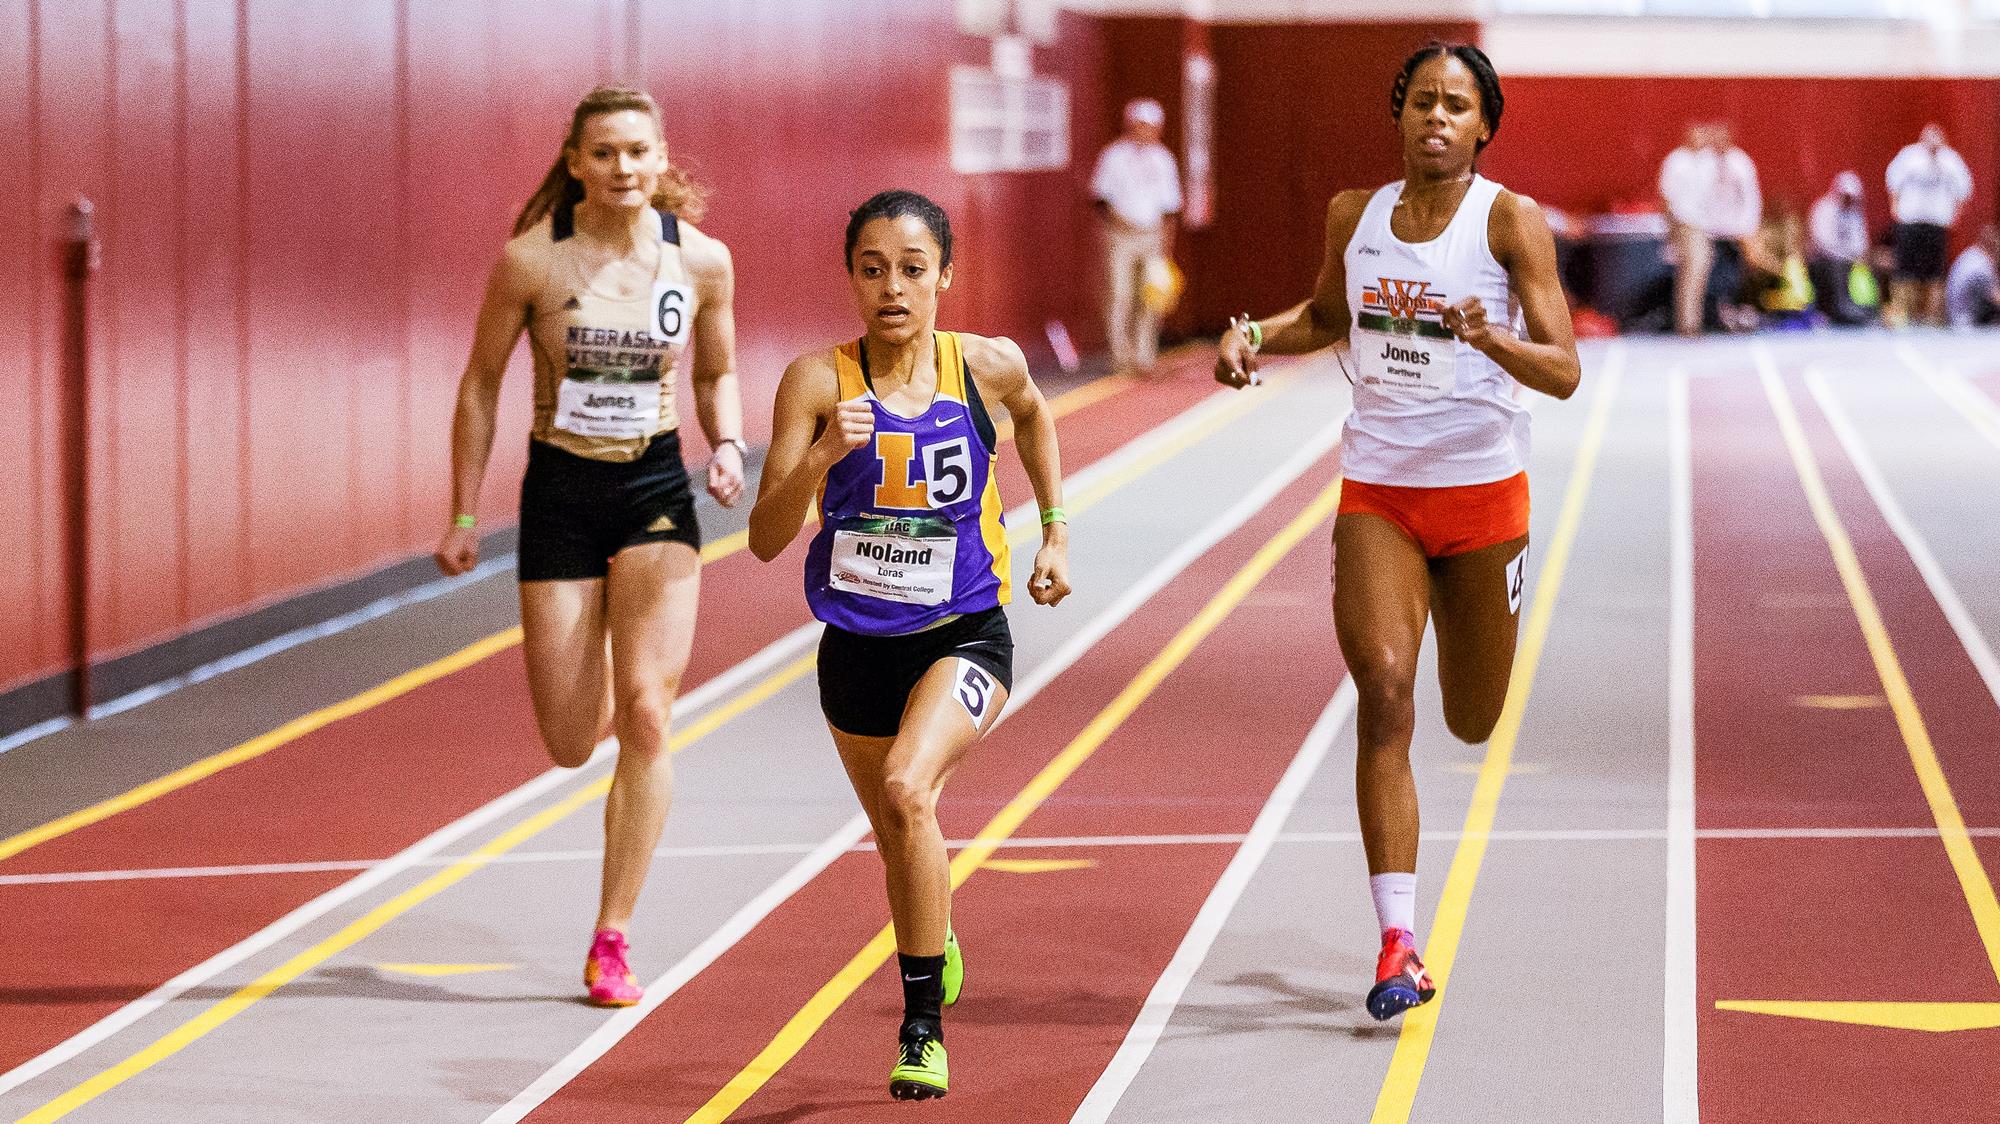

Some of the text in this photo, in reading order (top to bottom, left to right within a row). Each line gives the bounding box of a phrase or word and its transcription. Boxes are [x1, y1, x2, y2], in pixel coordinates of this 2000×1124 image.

[658, 289, 684, 337] 6
[1378, 277, 1431, 320] W
[1381, 342, 1431, 365] Jones
[873, 431, 938, 510] L
[932, 444, 967, 504] 5
[856, 541, 932, 565] Noland
[877, 567, 904, 578] Loras
[960, 666, 990, 717] 5
